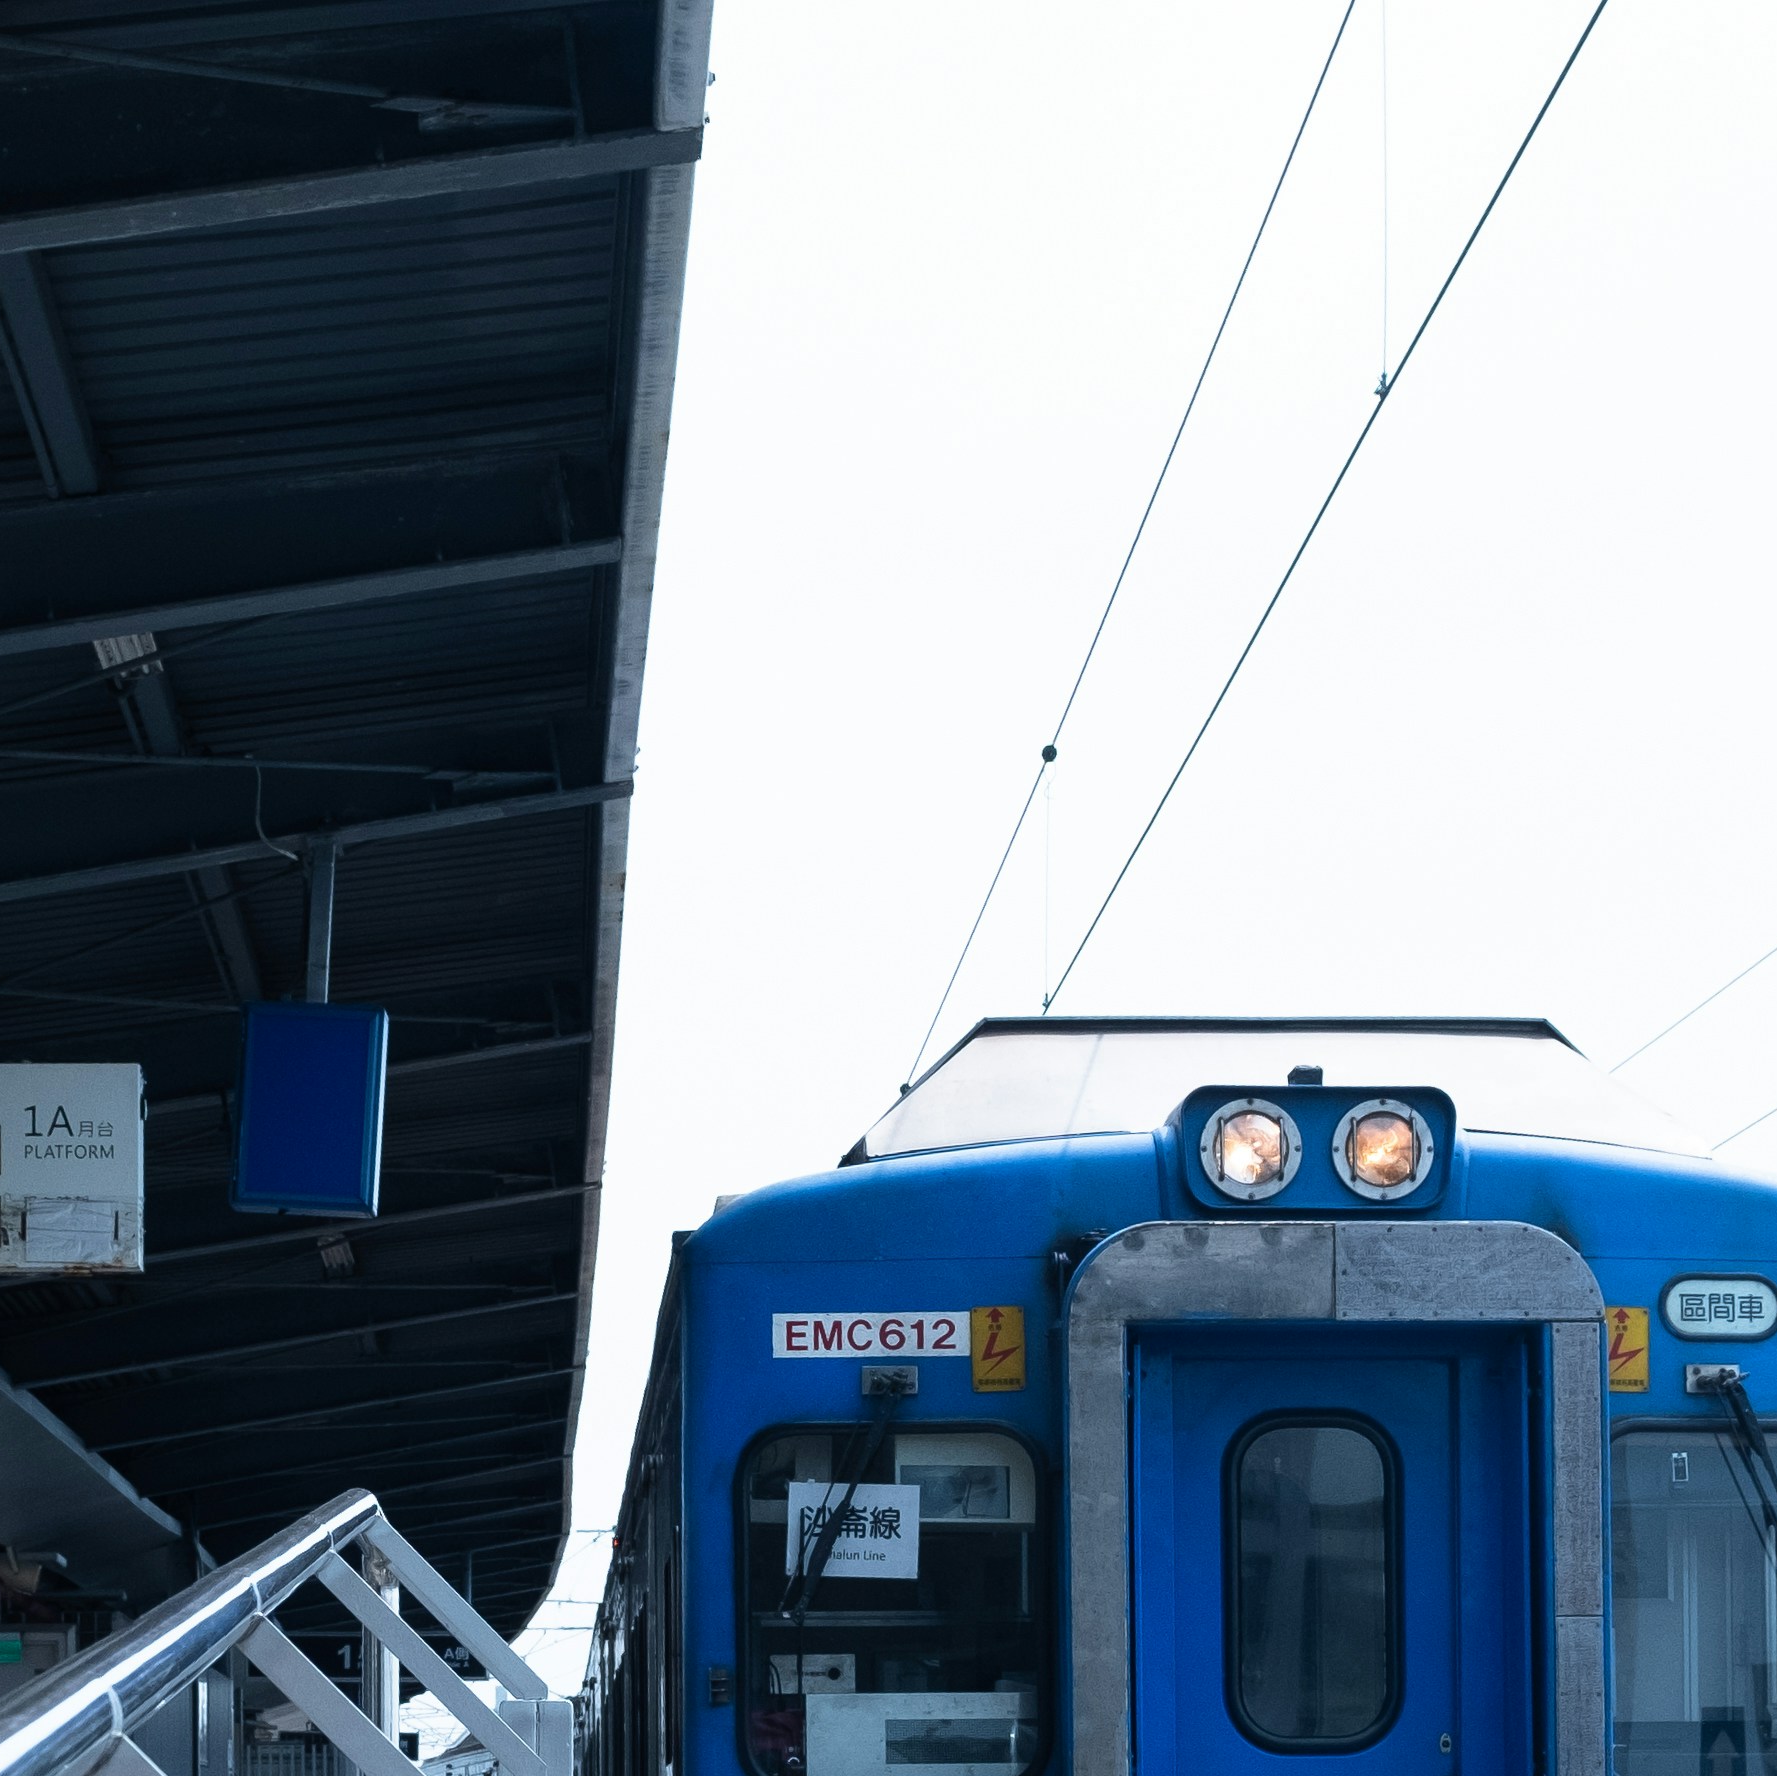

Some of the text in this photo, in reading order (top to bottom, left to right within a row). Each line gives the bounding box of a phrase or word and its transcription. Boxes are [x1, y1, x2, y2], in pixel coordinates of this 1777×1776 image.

[24, 1144, 115, 1160] PLATFORM
[1679, 1292, 1765, 1323] 區間車
[785, 1319, 956, 1351] EMC612
[863, 1549, 887, 1562] Line
